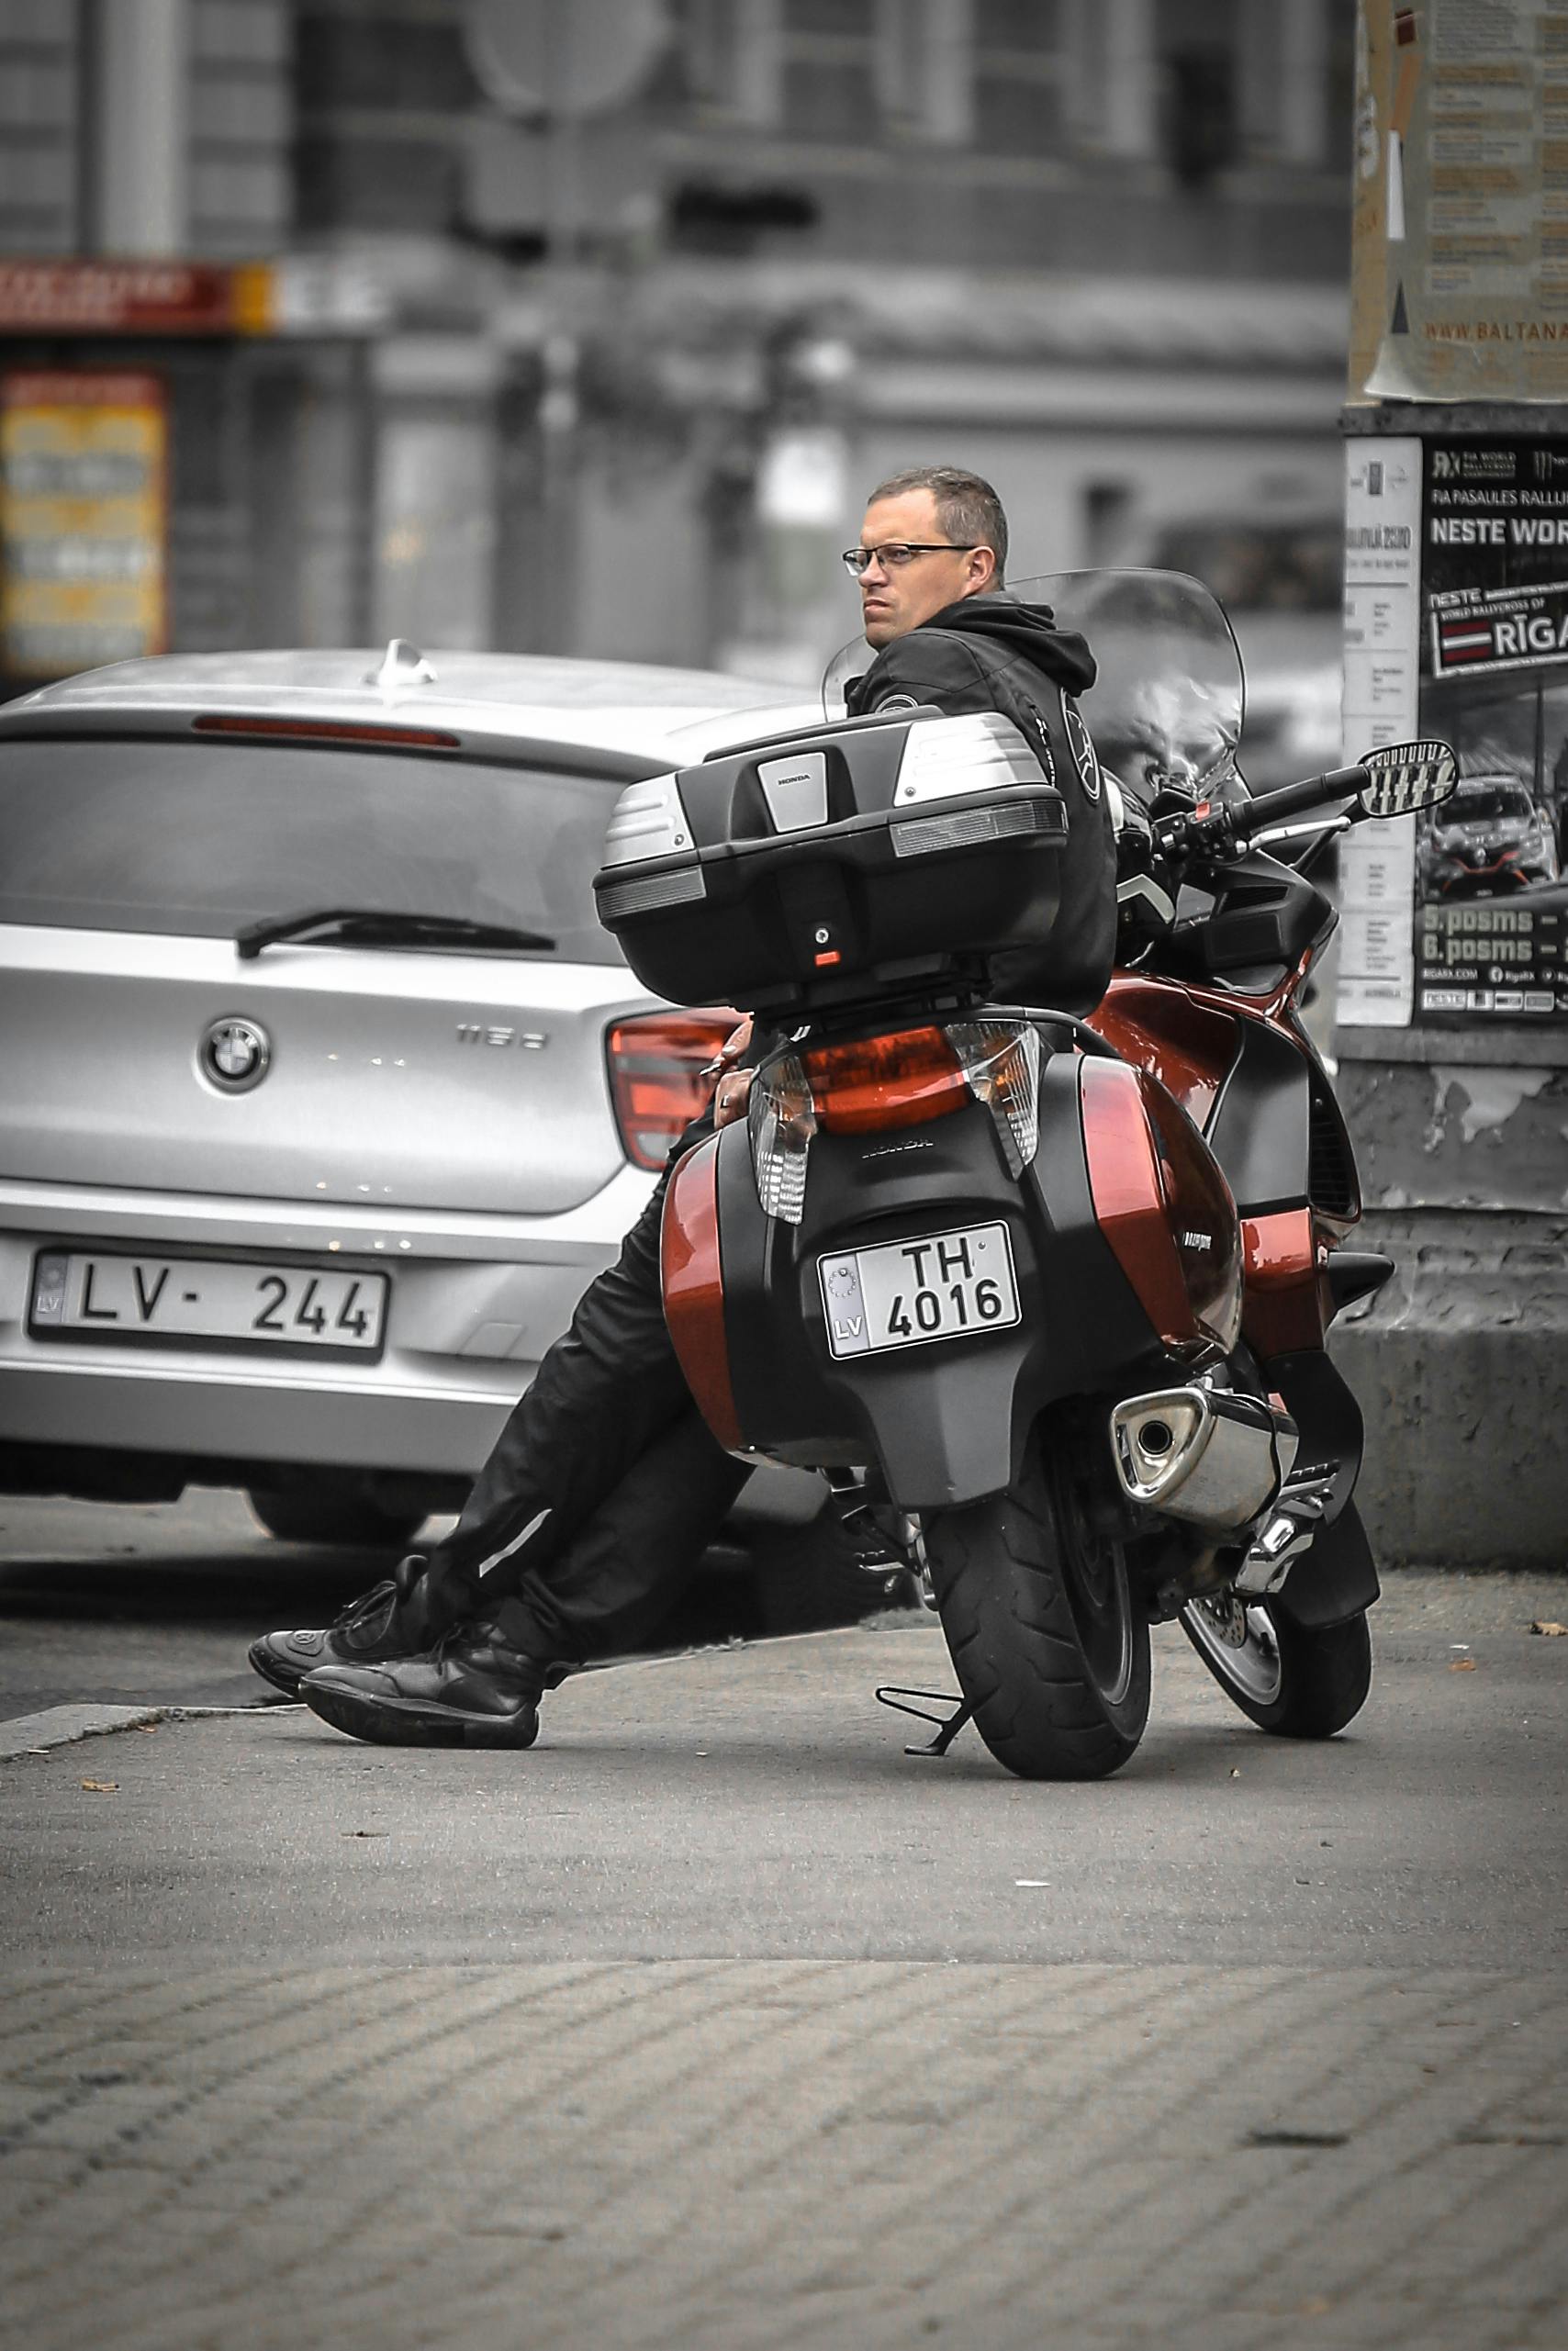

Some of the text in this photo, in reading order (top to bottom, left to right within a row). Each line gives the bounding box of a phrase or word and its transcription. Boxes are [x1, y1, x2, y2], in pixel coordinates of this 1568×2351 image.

[1452, 488, 1518, 506] PASAULES
[1520, 489, 1568, 506] RALLIJ
[1431, 517, 1506, 544] NESTE
[778, 774, 811, 786] HONDA
[901, 1237, 973, 1288] TH
[888, 1279, 1003, 1337] 4016
[834, 1315, 863, 1340] LV
